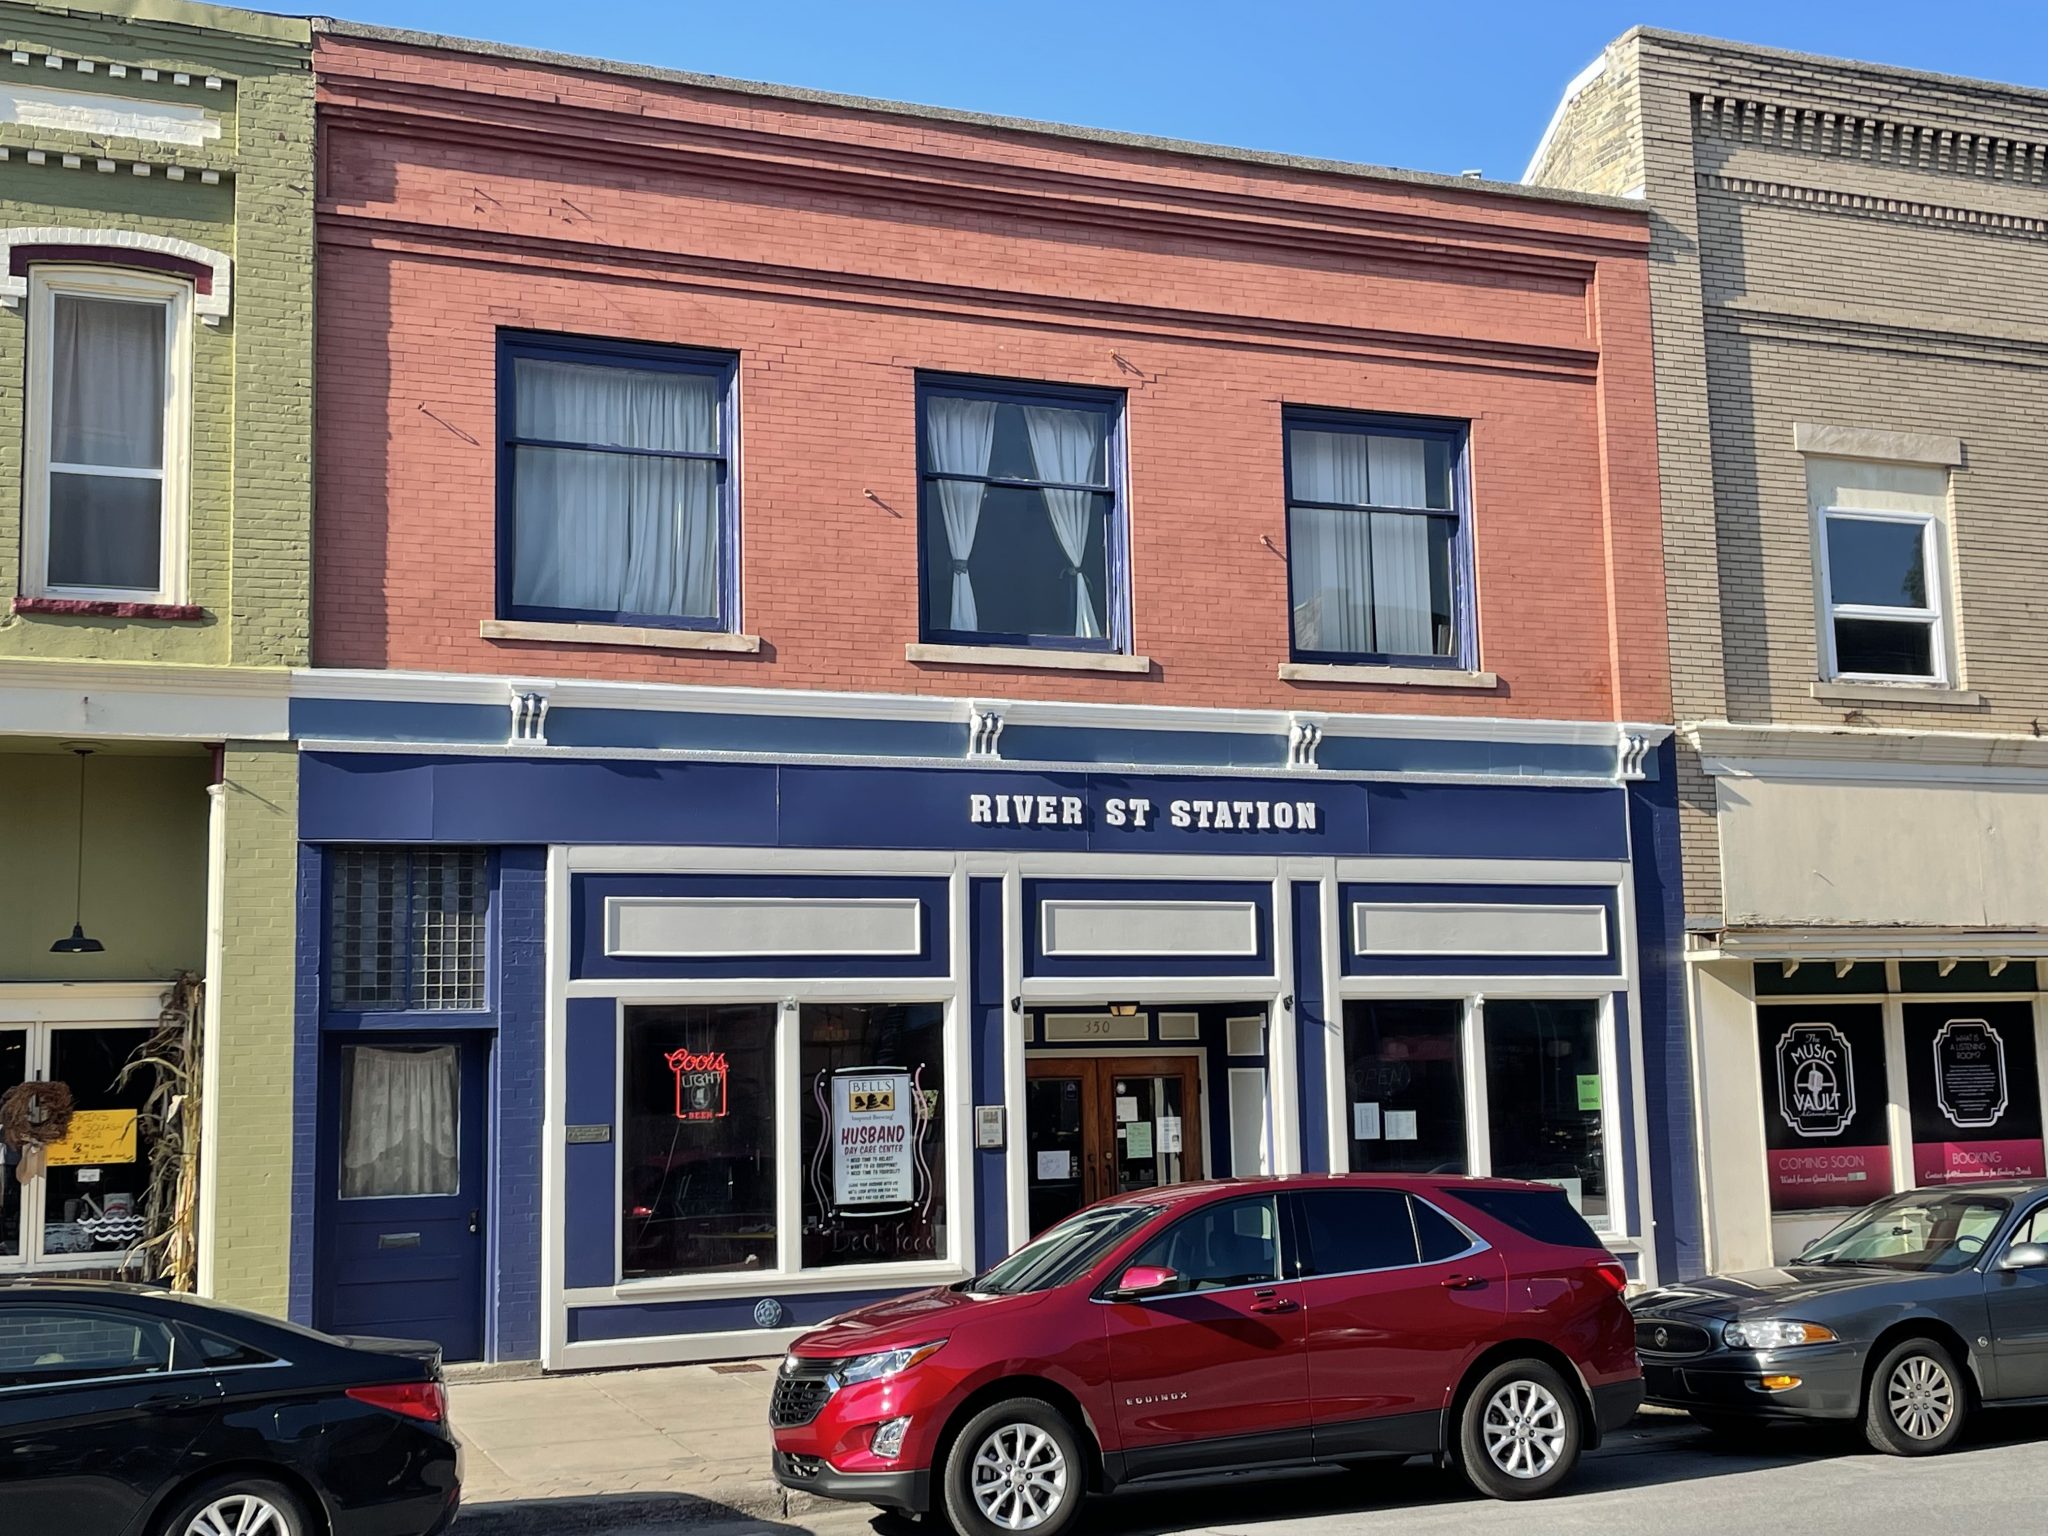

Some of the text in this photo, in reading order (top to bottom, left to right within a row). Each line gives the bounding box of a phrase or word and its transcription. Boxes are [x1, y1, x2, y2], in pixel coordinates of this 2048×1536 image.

[970, 793, 1317, 830] RIVER ST STATION
[1083, 1020, 1110, 1034] 350
[664, 1048, 729, 1072] Coors
[1790, 1043, 1837, 1066] MUSIC
[682, 1071, 721, 1097] LIGHT
[852, 1081, 892, 1092] BELL'S
[1793, 1092, 1841, 1112] VAULT
[688, 1111, 713, 1119] BEER
[841, 1124, 905, 1145] HUSBAND
[844, 1144, 903, 1156] DAY CARE CENTER
[1952, 1151, 2002, 1165] BOOKING
[1779, 1155, 1865, 1171] COMING SOON
[1126, 1391, 1188, 1405] EQUINOX
